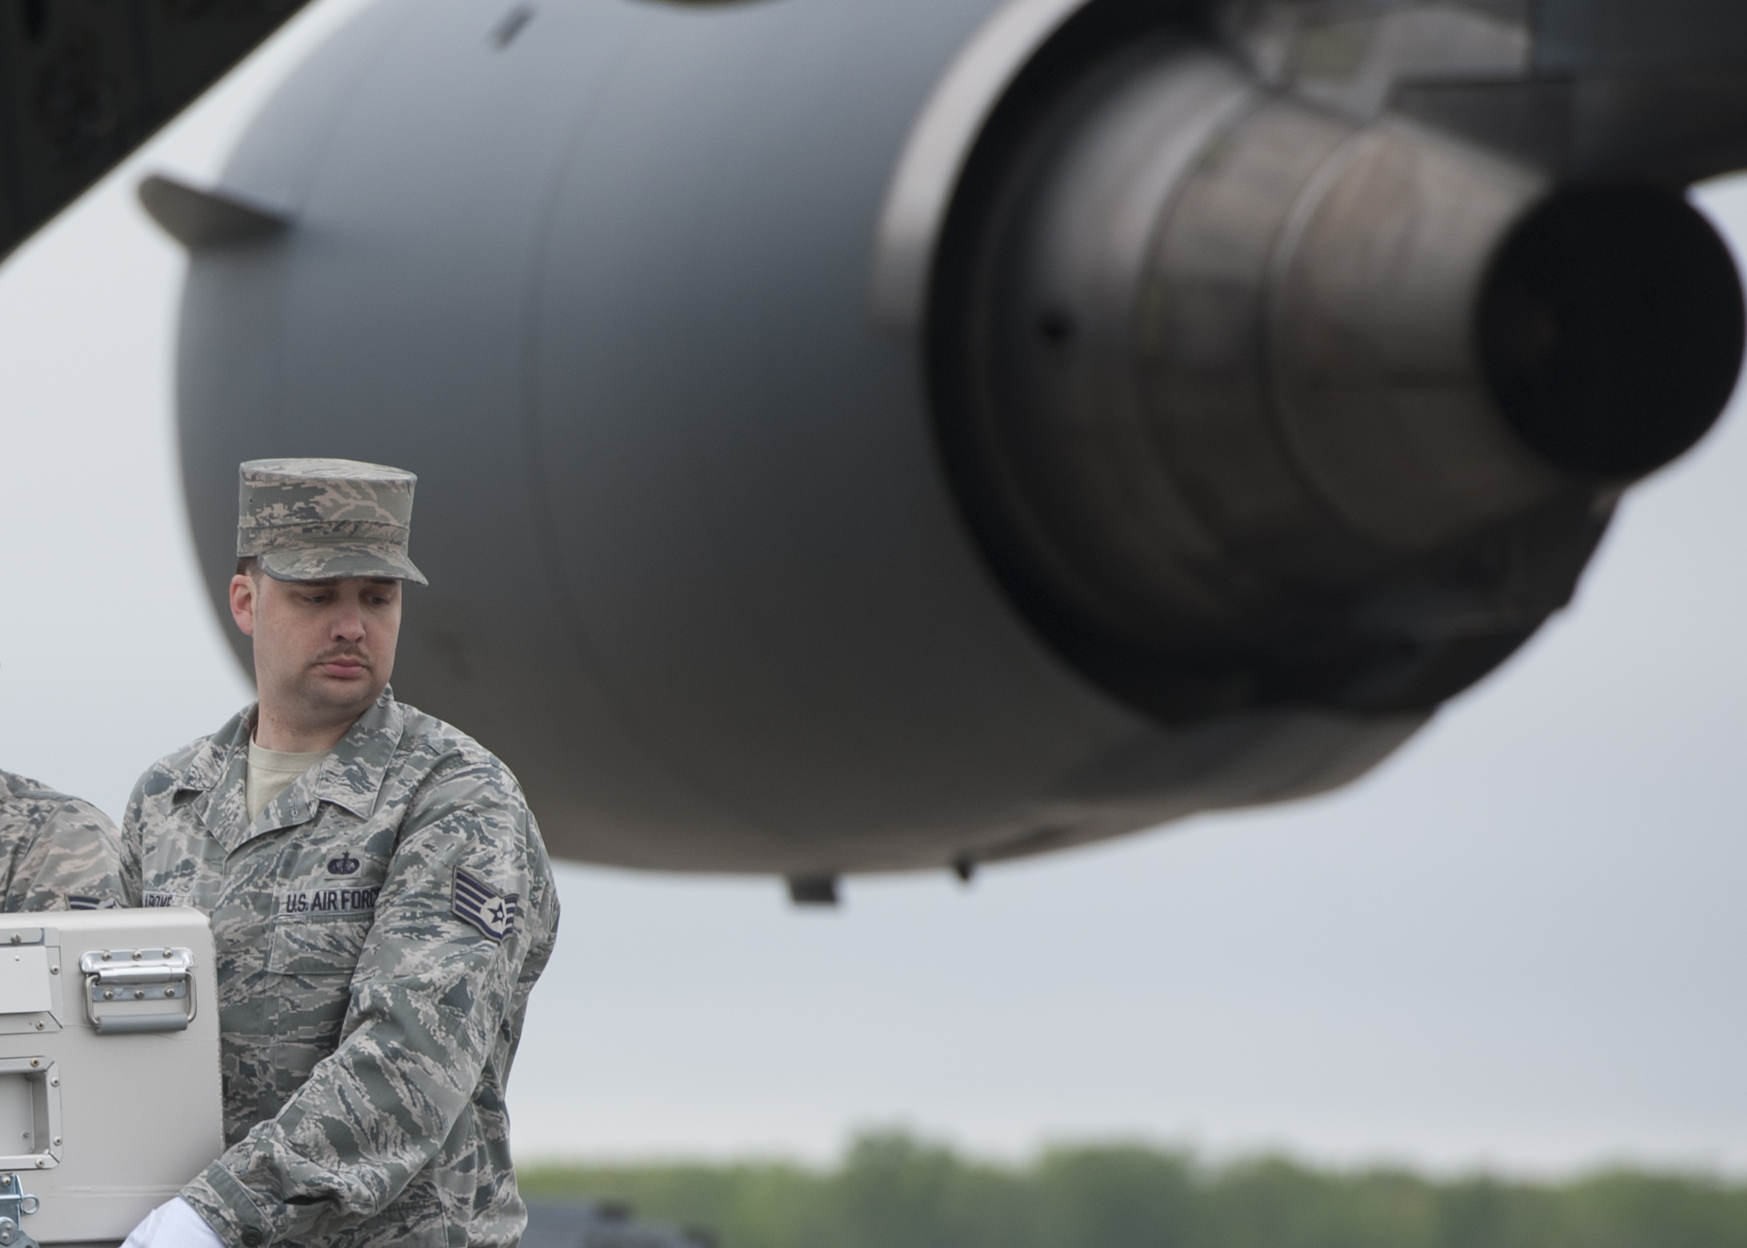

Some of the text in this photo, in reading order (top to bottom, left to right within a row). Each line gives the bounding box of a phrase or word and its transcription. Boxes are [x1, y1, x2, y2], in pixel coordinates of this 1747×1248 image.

[286, 887, 381, 913] U.S. AIR FORC
